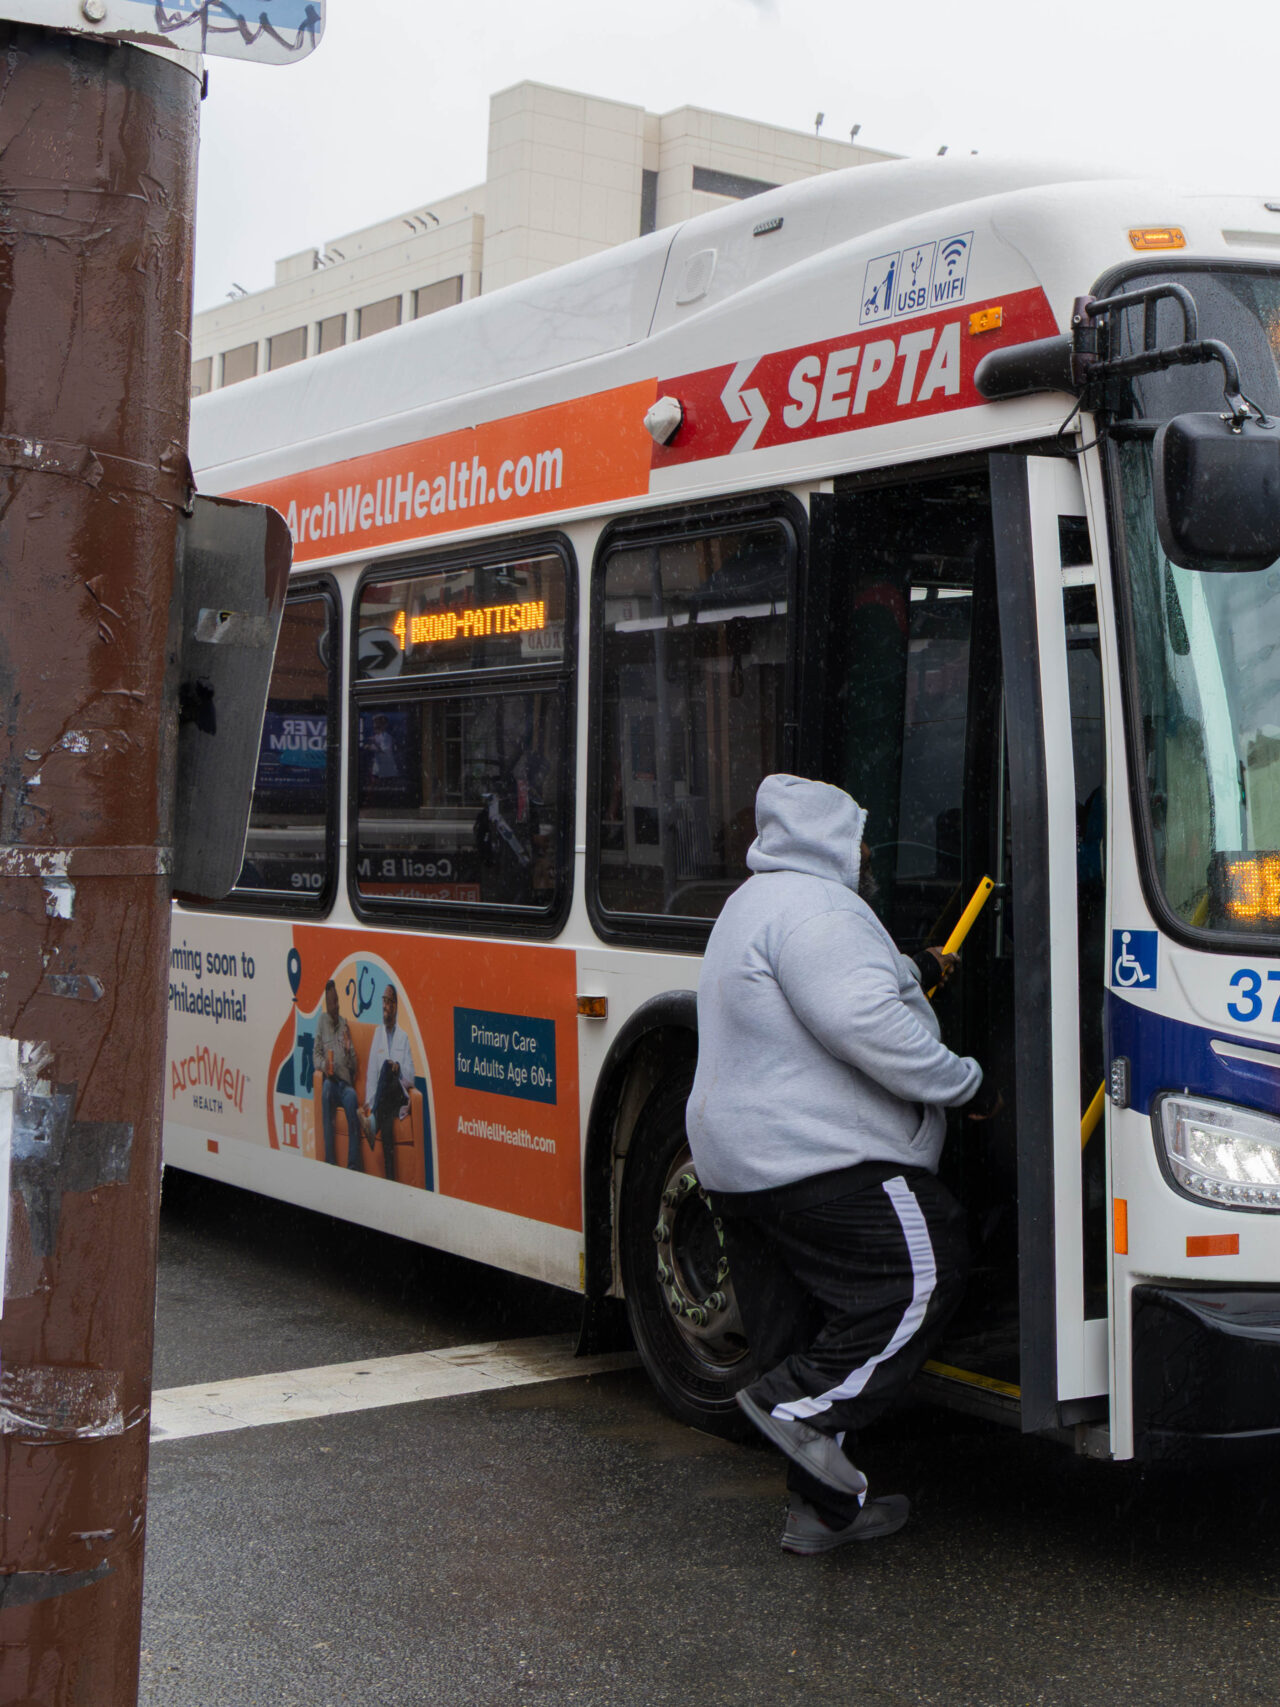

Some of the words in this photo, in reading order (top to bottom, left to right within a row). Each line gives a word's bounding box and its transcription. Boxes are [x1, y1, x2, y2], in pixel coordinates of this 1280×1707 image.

[897, 287, 927, 312] USB
[934, 276, 965, 303] WIFI
[782, 321, 961, 429] SEPTA
[286, 447, 563, 544] ArchWellHealth.com
[393, 610, 407, 650] 4
[410, 600, 545, 644] BROAD-PATTISON
[206, 951, 238, 978] soon
[241, 950, 255, 980] to
[168, 982, 247, 1025] Philadelphia!
[471, 1024, 510, 1053] Primary
[511, 1030, 537, 1053] Care
[171, 1044, 246, 1114] ArchWell
[457, 1052, 471, 1073] for
[473, 1056, 505, 1080] Adults
[507, 1062, 528, 1087] Age
[530, 1067, 553, 1088] 60+
[192, 1094, 224, 1114] HEALTH
[456, 1115, 557, 1155] ArchWellHealth.com
